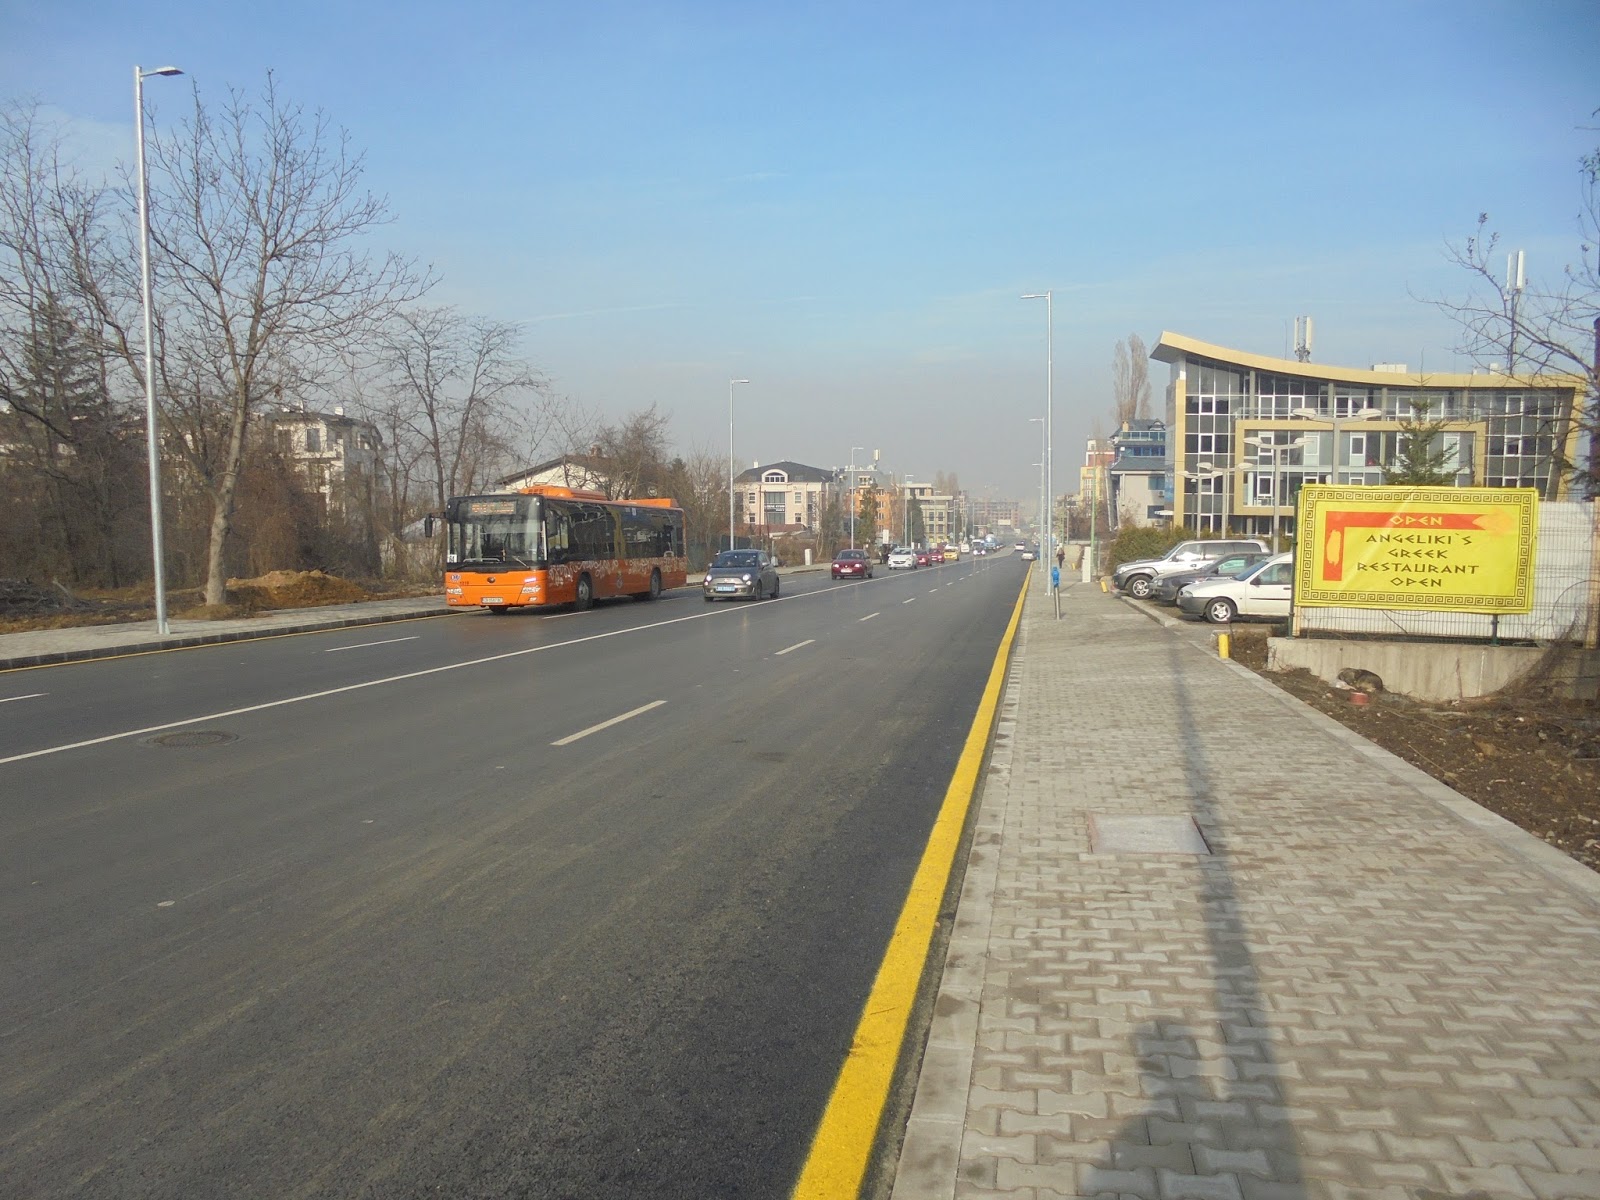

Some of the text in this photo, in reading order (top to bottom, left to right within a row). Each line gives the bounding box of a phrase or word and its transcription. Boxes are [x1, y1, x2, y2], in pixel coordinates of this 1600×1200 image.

[1390, 515, 1442, 526] OPEN
[1388, 548, 1448, 559] GREEK
[1357, 562, 1479, 574] RESTAURANT
[1390, 577, 1442, 587] OPEN
